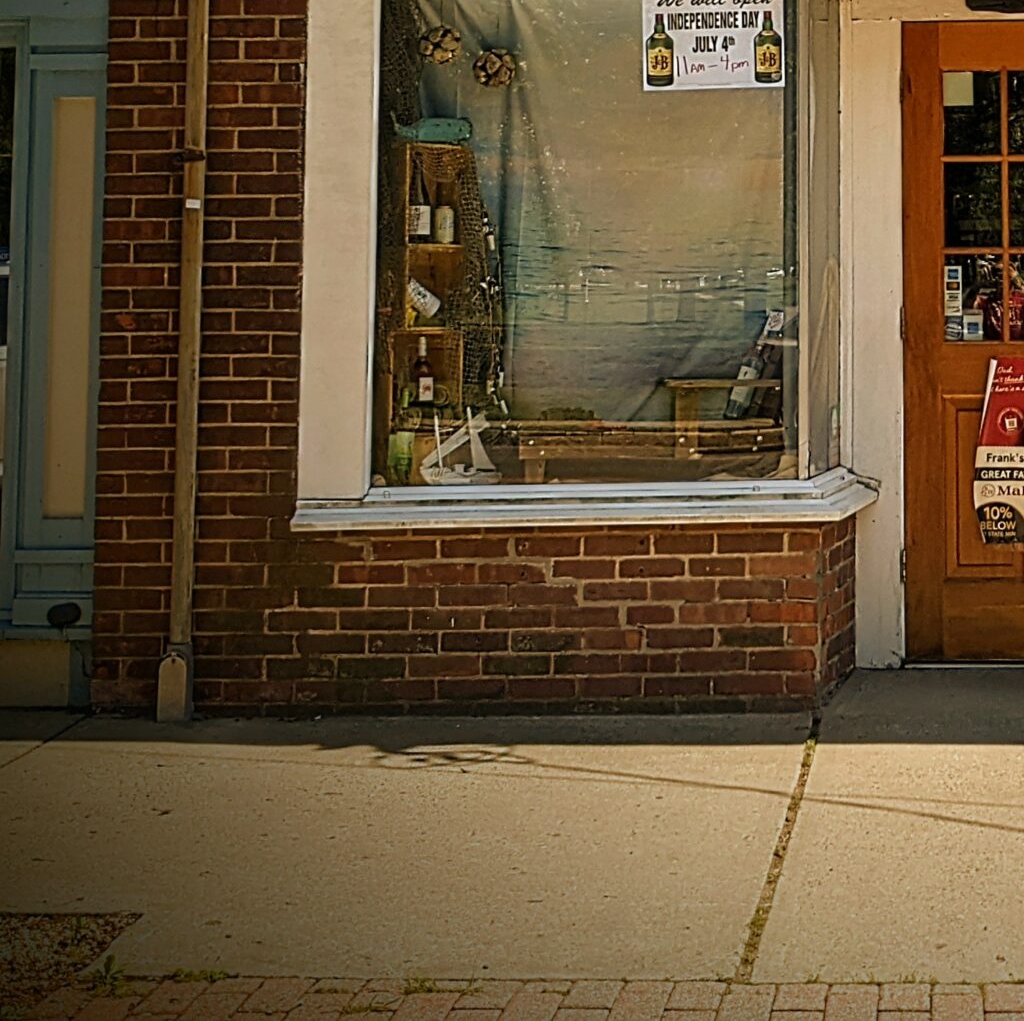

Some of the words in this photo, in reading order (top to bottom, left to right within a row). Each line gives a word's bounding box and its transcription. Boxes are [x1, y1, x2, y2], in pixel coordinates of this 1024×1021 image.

[667, 12, 739, 30] INDEPENDENCE
[741, 11, 760, 28] DAY
[692, 36, 718, 53] JULY
[721, 36, 736, 52] 4th
[986, 453, 1024, 463] Frank's
[980, 470, 1011, 479] GREAT
[983, 506, 1013, 520] 10%
[980, 521, 1016, 530] BELOW
